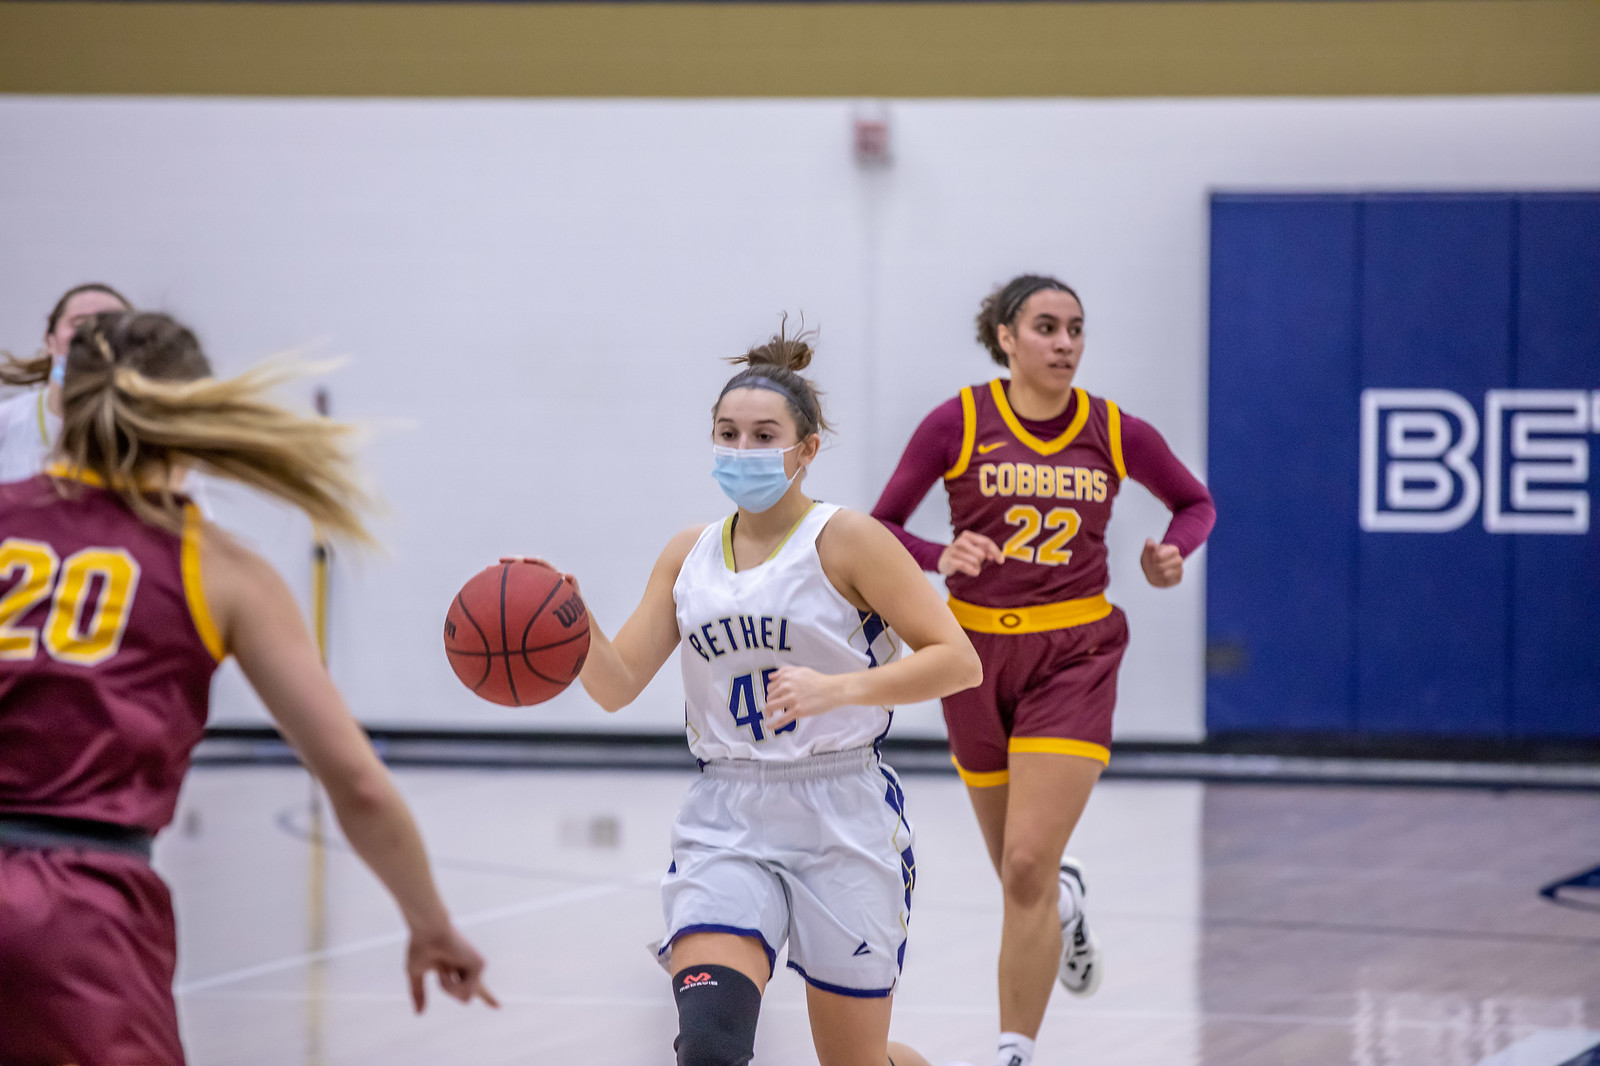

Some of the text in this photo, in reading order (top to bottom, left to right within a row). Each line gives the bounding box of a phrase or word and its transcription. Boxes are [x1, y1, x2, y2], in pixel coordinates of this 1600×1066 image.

[979, 462, 1108, 503] COBBERS
[1359, 387, 1600, 535] BE
[1002, 504, 1082, 566] 22
[0, 537, 142, 667] 20
[688, 615, 792, 663] BETHEL
